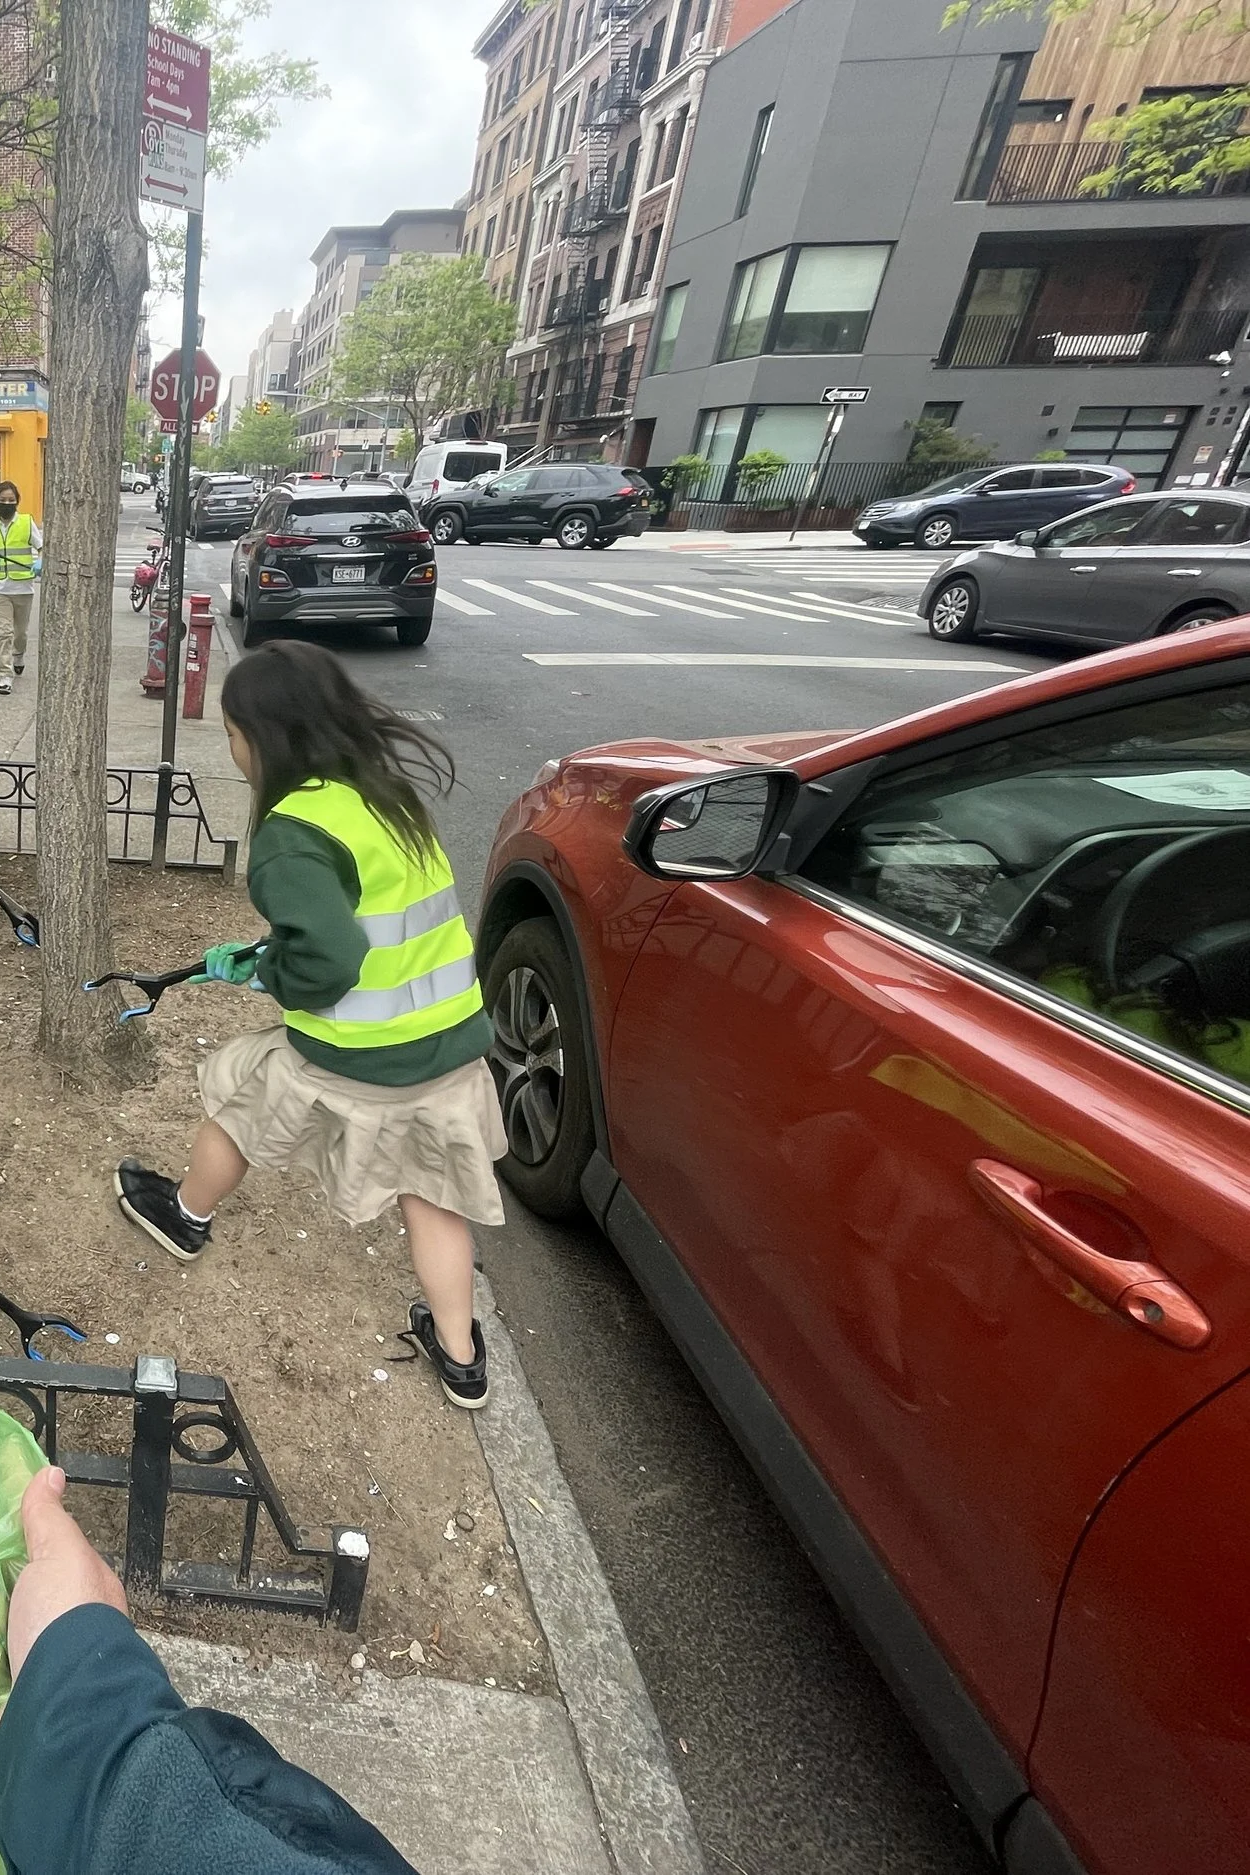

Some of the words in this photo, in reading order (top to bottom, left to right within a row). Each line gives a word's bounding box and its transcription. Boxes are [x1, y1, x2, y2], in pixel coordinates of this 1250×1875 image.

[147, 31, 160, 50] NO
[161, 36, 201, 68] STANDING
[147, 53, 169, 73] School
[170, 62, 184, 82] Days
[147, 71, 160, 88] 7am
[166, 78, 180, 96] 4pm
[162, 422, 178, 431] ALL
